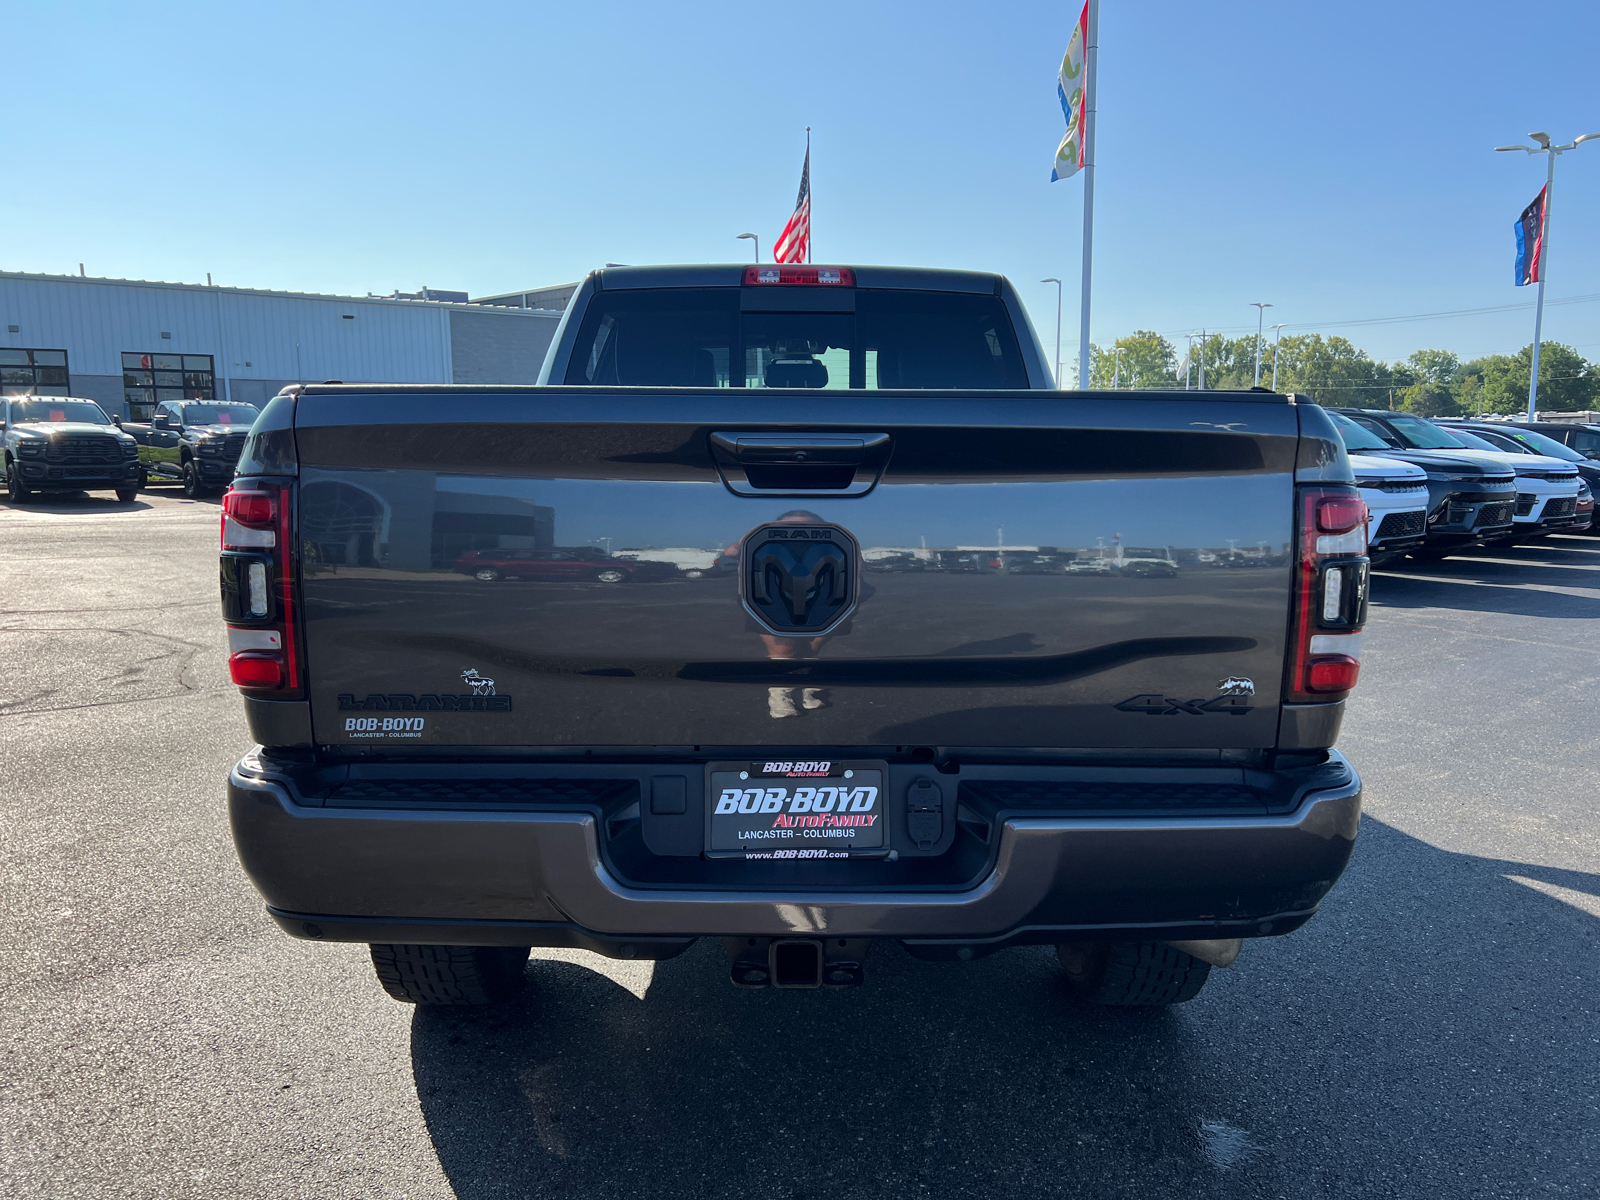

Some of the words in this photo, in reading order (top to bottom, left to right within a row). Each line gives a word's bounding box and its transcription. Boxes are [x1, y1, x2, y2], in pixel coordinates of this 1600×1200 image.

[768, 529, 832, 539] RAM
[338, 694, 512, 712] LARAMIE
[345, 717, 425, 731] BOB-BOYD
[714, 786, 878, 815] BOB-BOYD
[738, 830, 794, 840] LANCASTER
[803, 828, 856, 839] COLUMBUS
